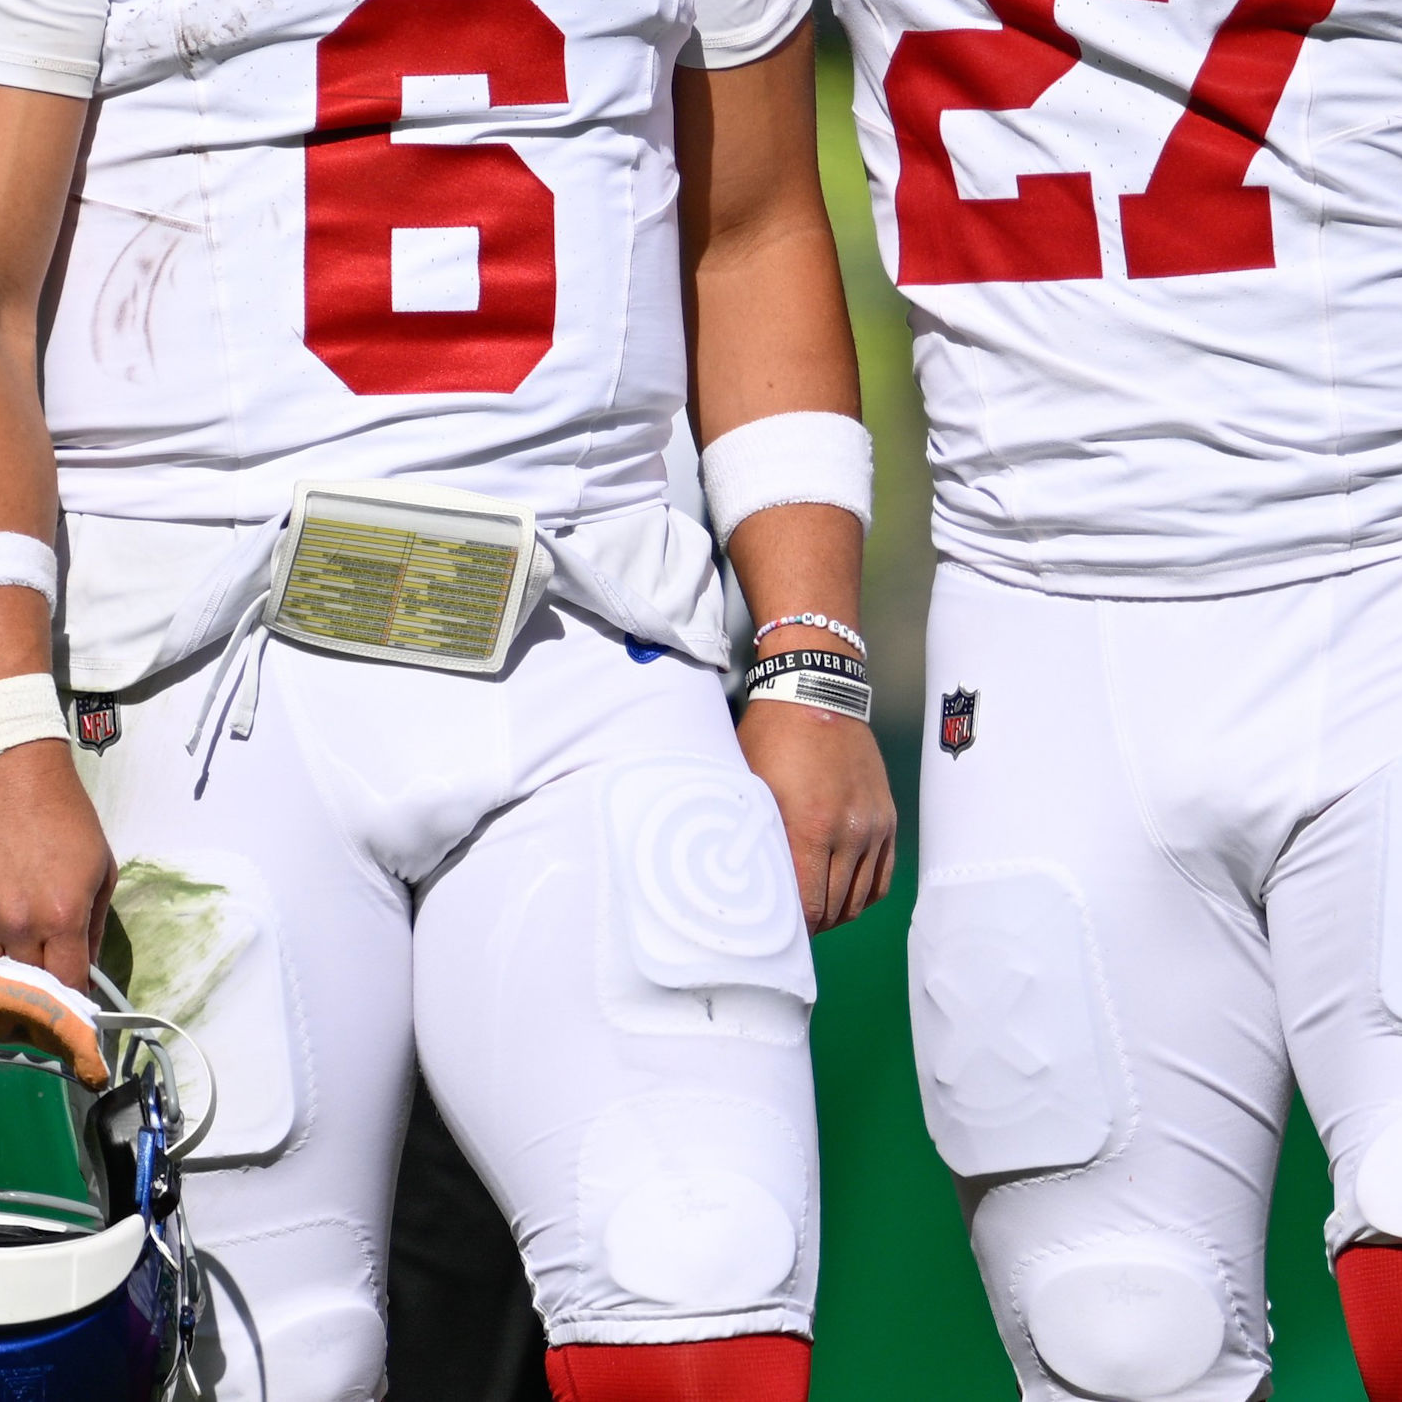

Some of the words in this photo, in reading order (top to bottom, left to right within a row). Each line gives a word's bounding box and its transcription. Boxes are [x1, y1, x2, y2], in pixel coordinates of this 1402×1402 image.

[801, 652, 842, 671] OVER
[81, 710, 115, 743] NFL
[943, 715, 971, 746] NFL
